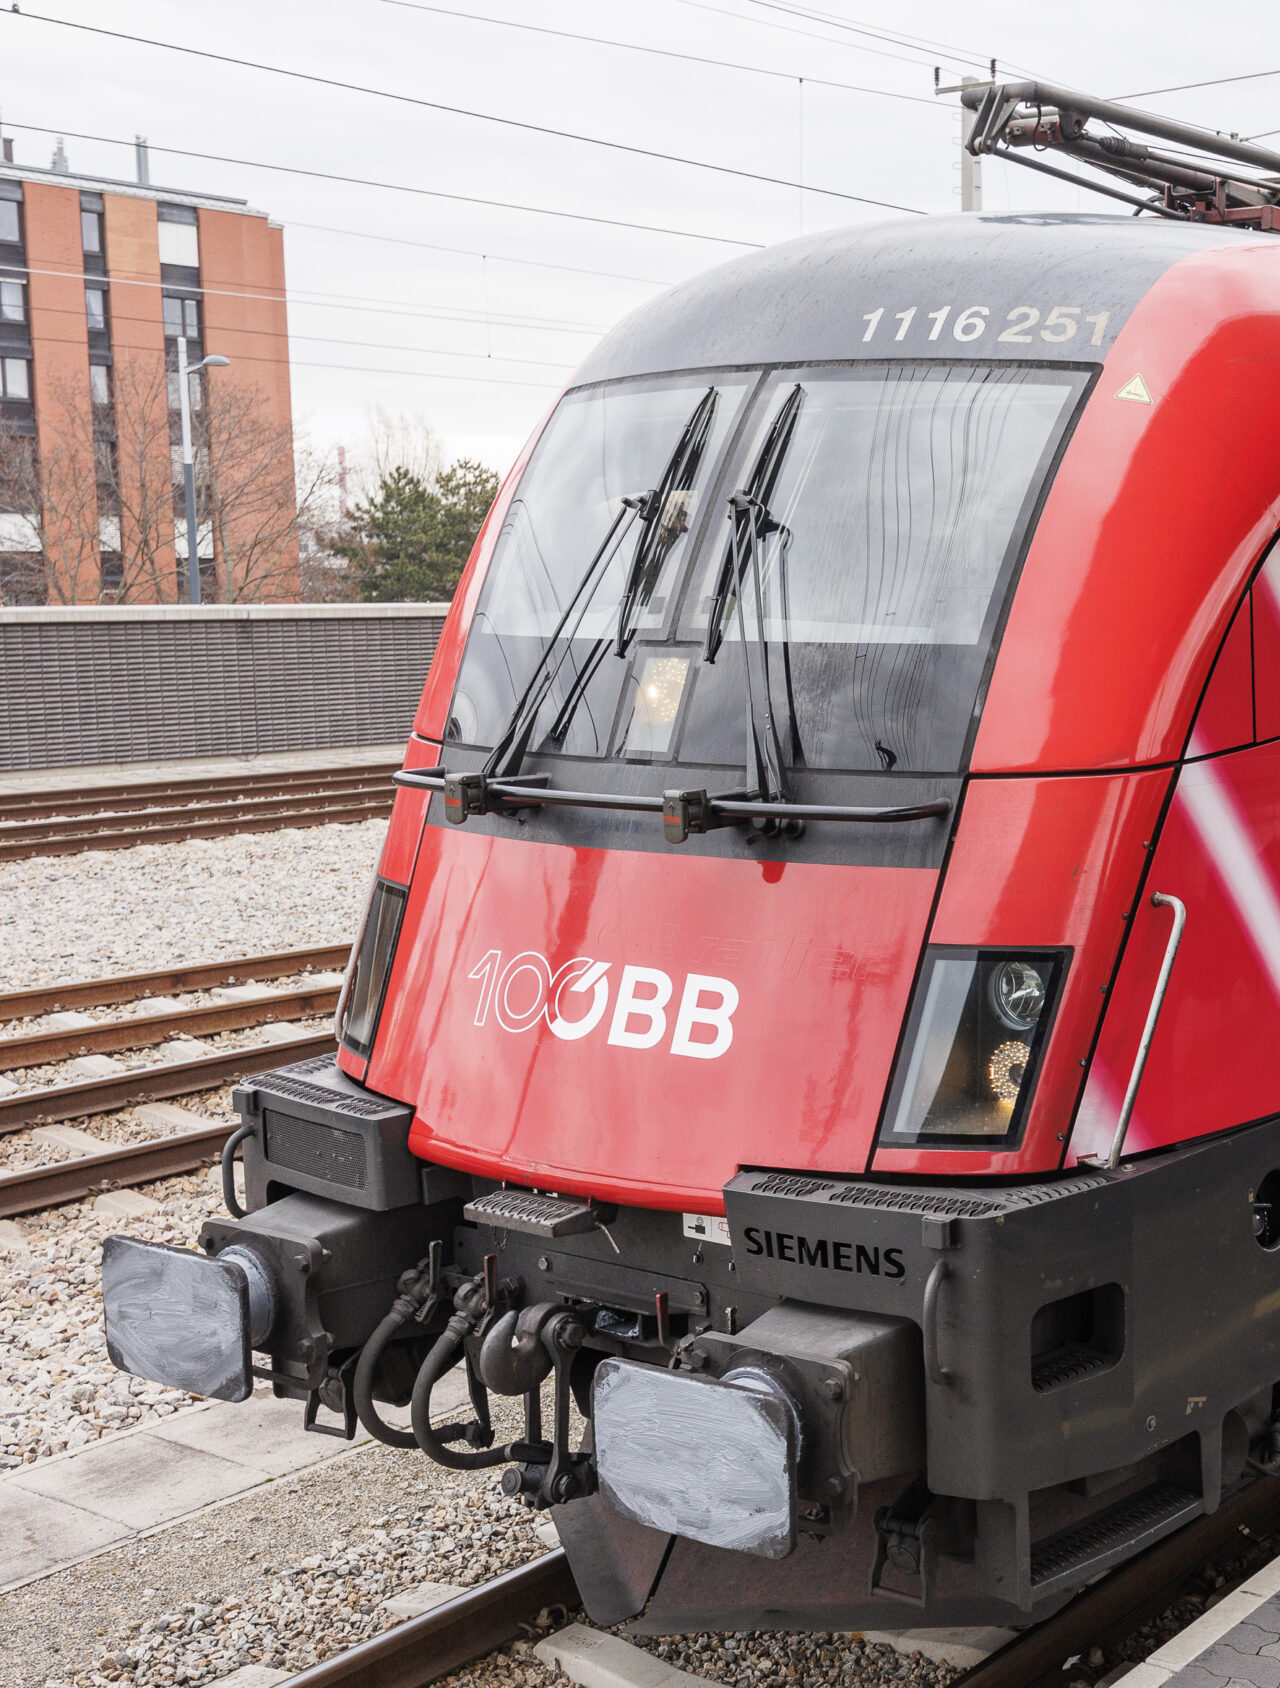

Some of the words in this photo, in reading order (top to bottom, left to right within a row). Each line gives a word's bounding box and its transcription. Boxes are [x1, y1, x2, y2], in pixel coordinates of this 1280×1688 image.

[862, 305, 990, 342] 1116
[997, 306, 1111, 346] 251
[743, 1227, 906, 1279] SIEMENS
